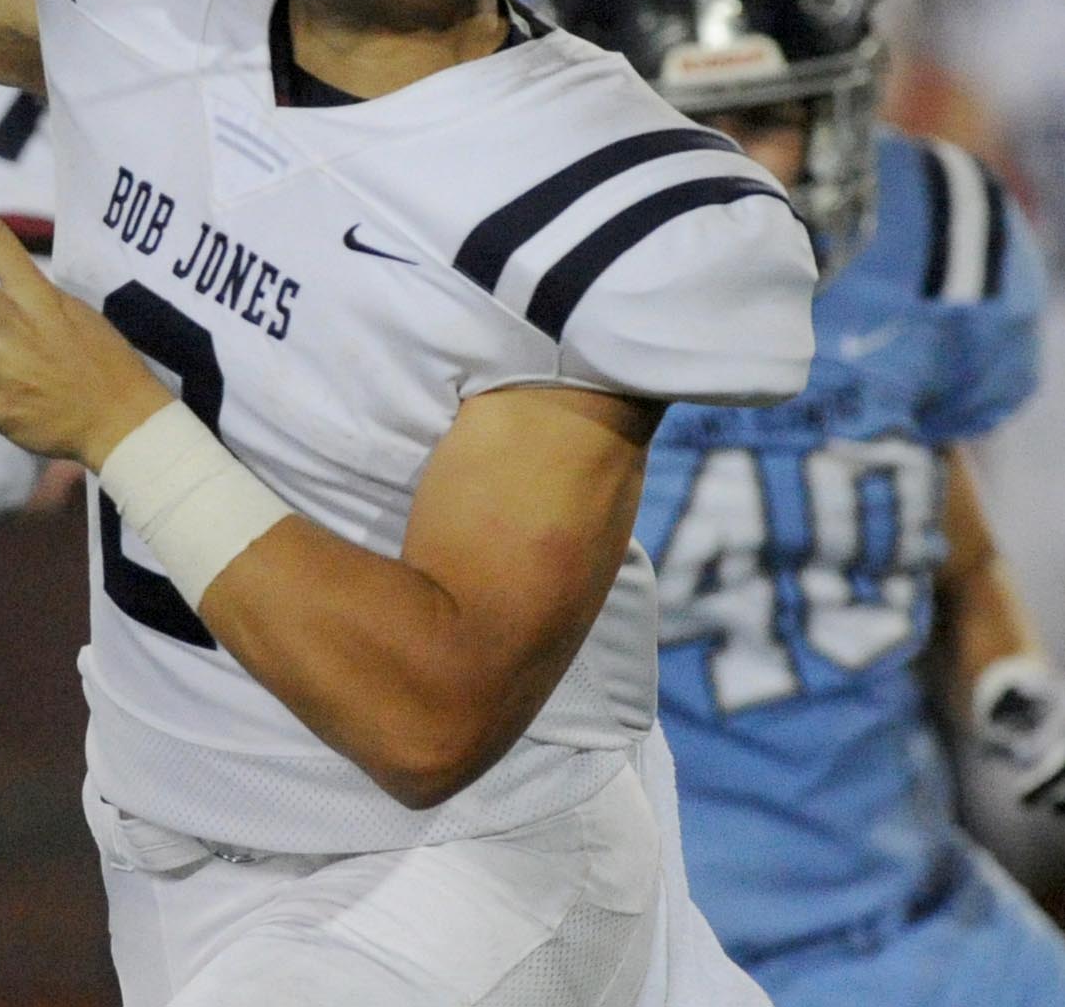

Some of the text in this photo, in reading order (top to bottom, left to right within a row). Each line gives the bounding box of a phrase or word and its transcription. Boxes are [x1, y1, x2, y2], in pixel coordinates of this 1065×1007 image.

[103, 166, 300, 340] BOB JONES
[655, 438, 933, 713] 40
